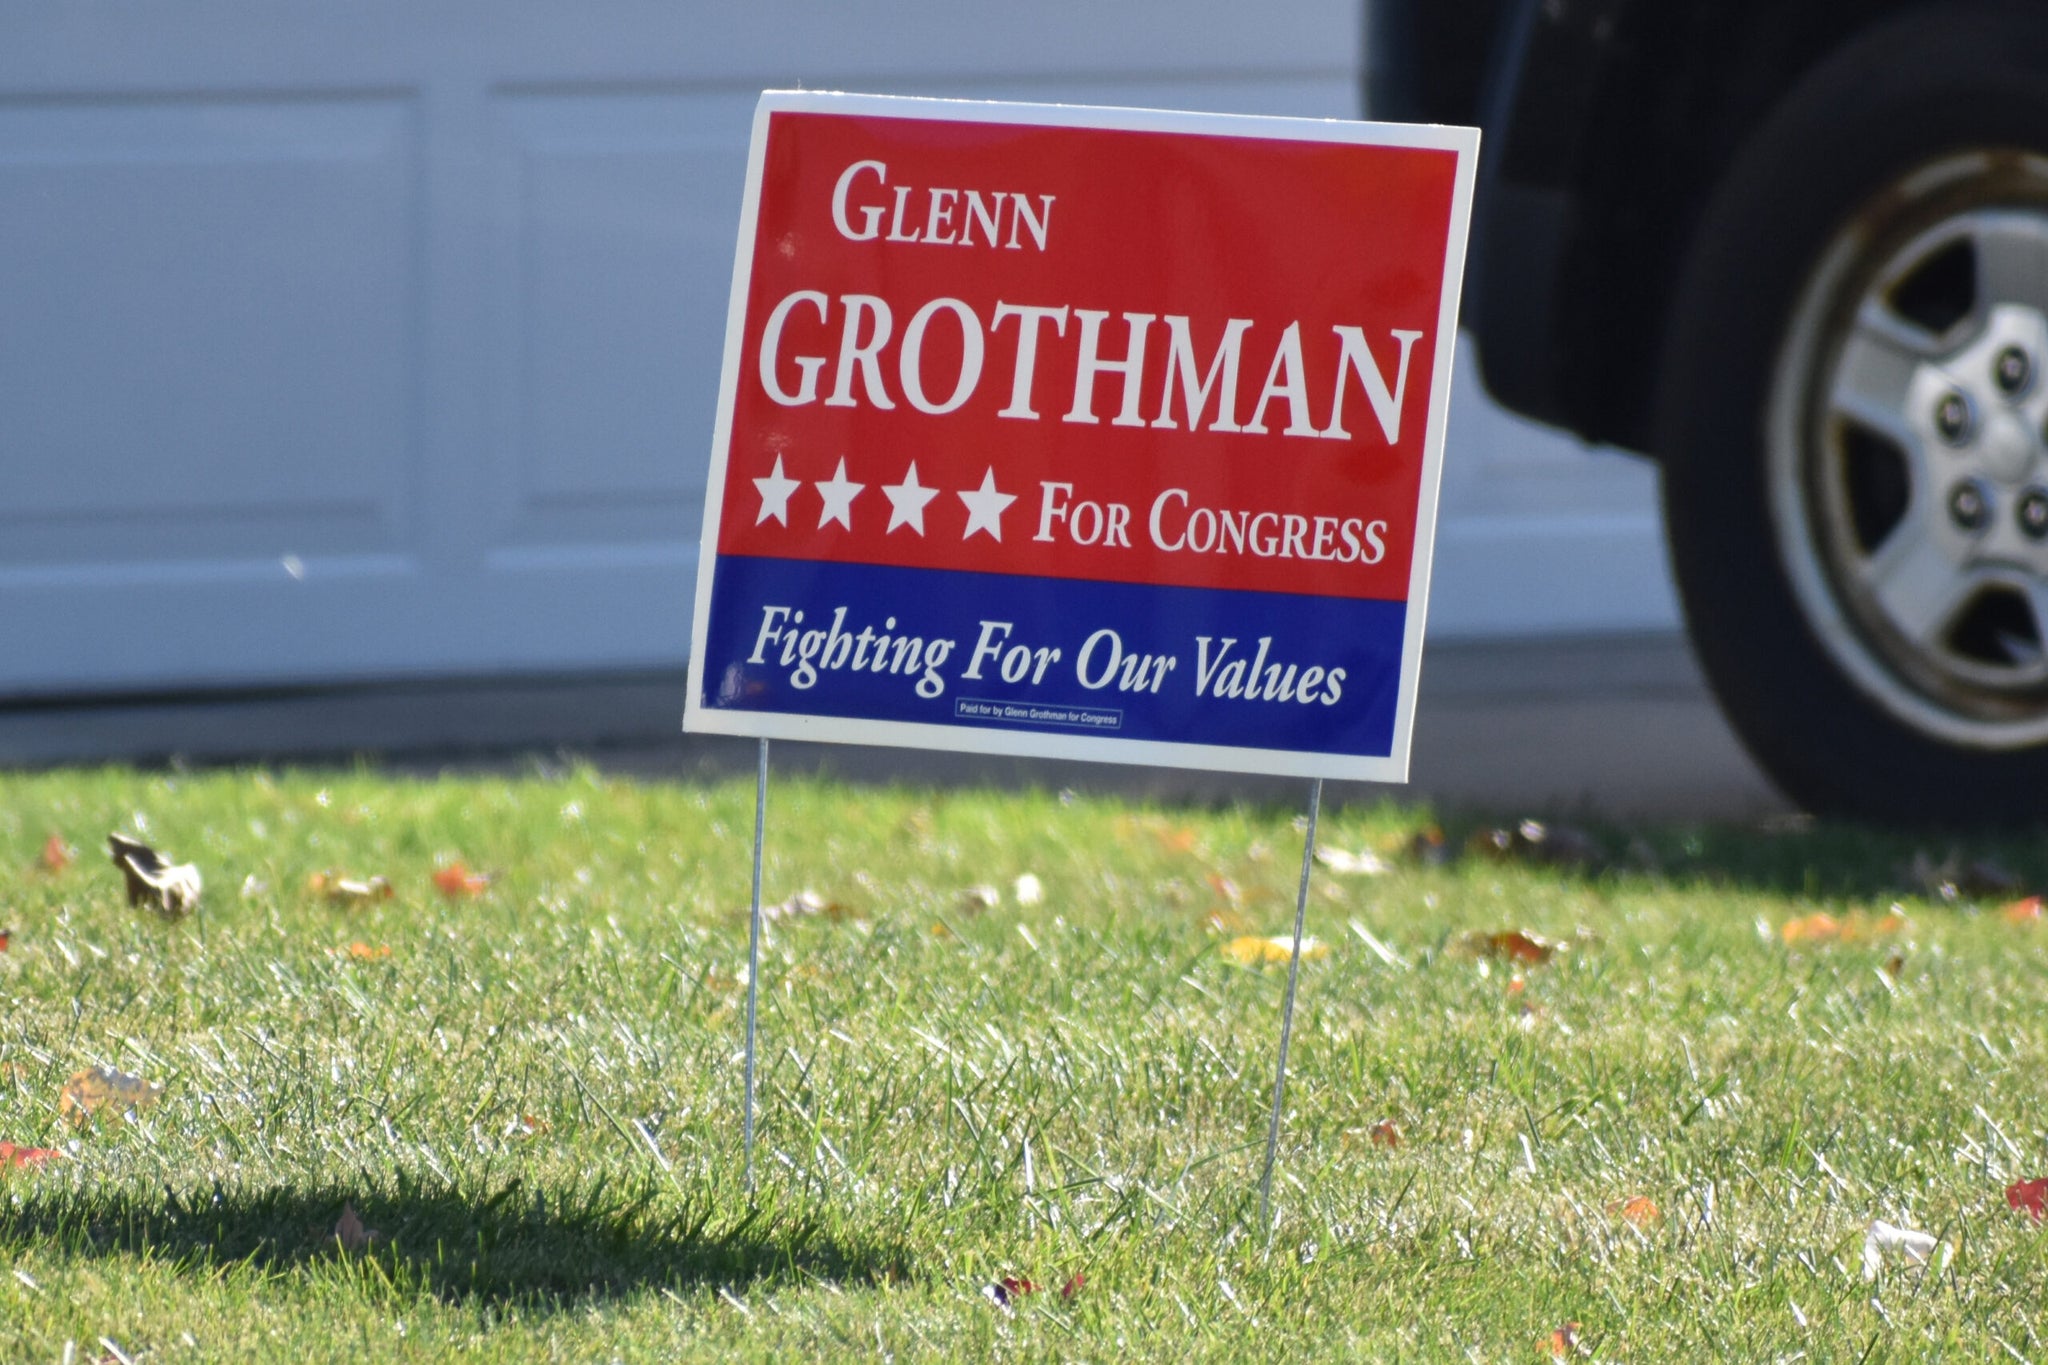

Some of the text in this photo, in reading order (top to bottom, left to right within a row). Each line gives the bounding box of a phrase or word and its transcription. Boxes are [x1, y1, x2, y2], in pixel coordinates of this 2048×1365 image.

[832, 161, 1056, 251] GLENN
[759, 290, 1424, 445] GROTHMAN
[1033, 481, 1387, 564] FOR CONGRESS
[747, 605, 1347, 706] Fighting For Our Values
[960, 702, 1118, 725] Paid for by Glenn Grothman for Congress
